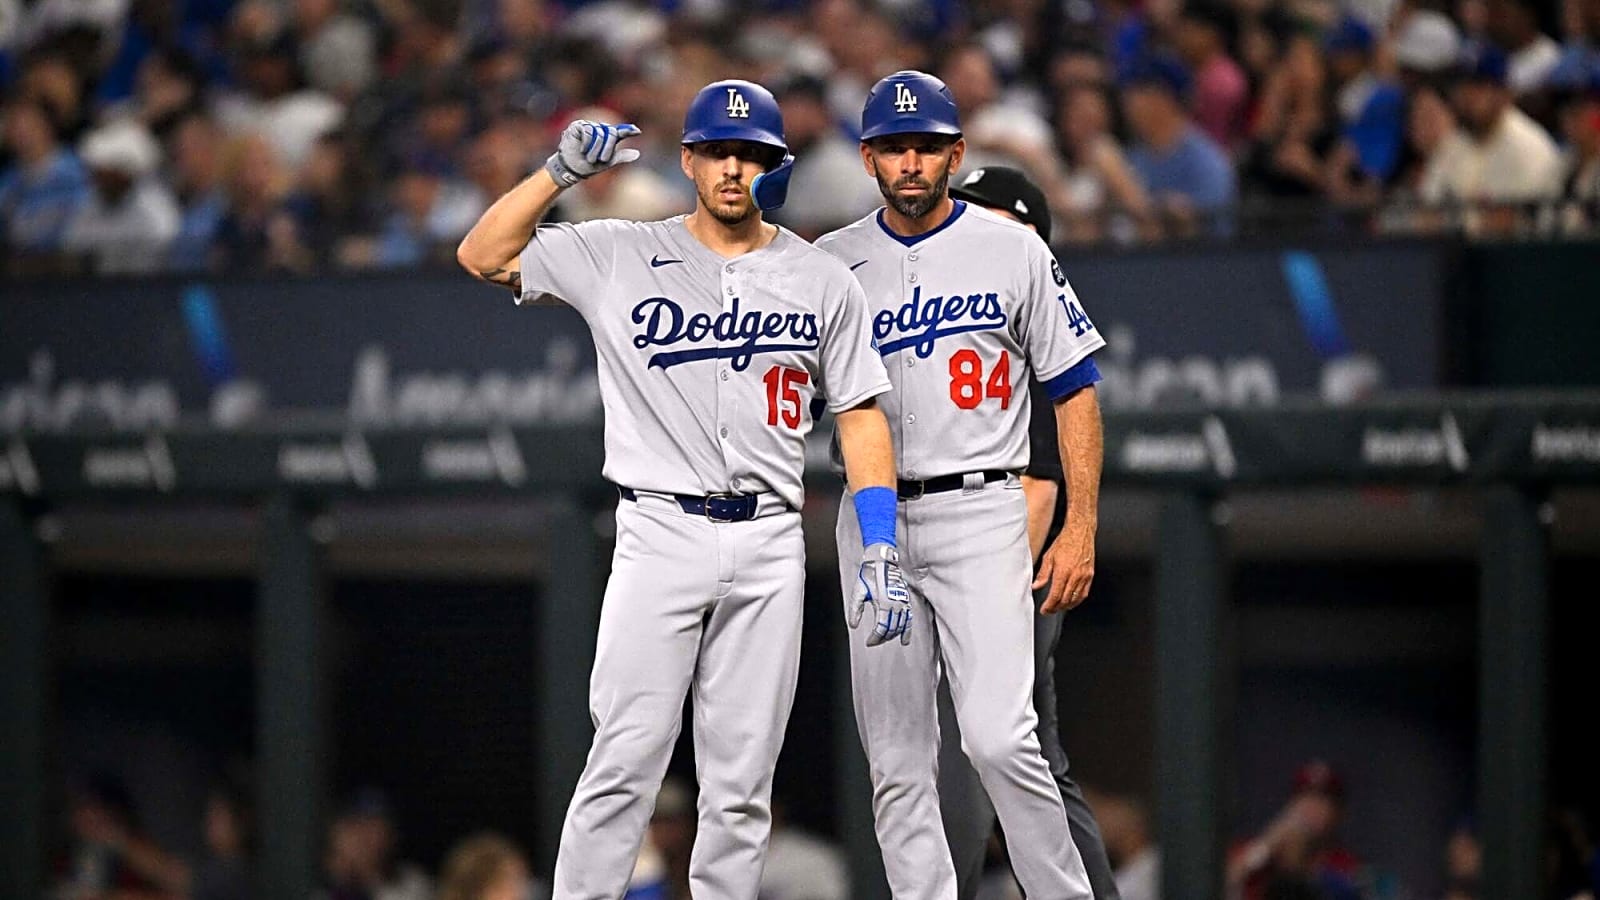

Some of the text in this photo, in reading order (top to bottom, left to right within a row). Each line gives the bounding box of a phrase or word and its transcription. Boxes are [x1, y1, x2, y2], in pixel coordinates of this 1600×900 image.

[727, 88, 749, 118] LA
[894, 83, 917, 112] LA
[631, 296, 820, 372] Dodgers
[873, 286, 1008, 359] odgers
[763, 364, 809, 430] 15
[949, 349, 1012, 410] 84
